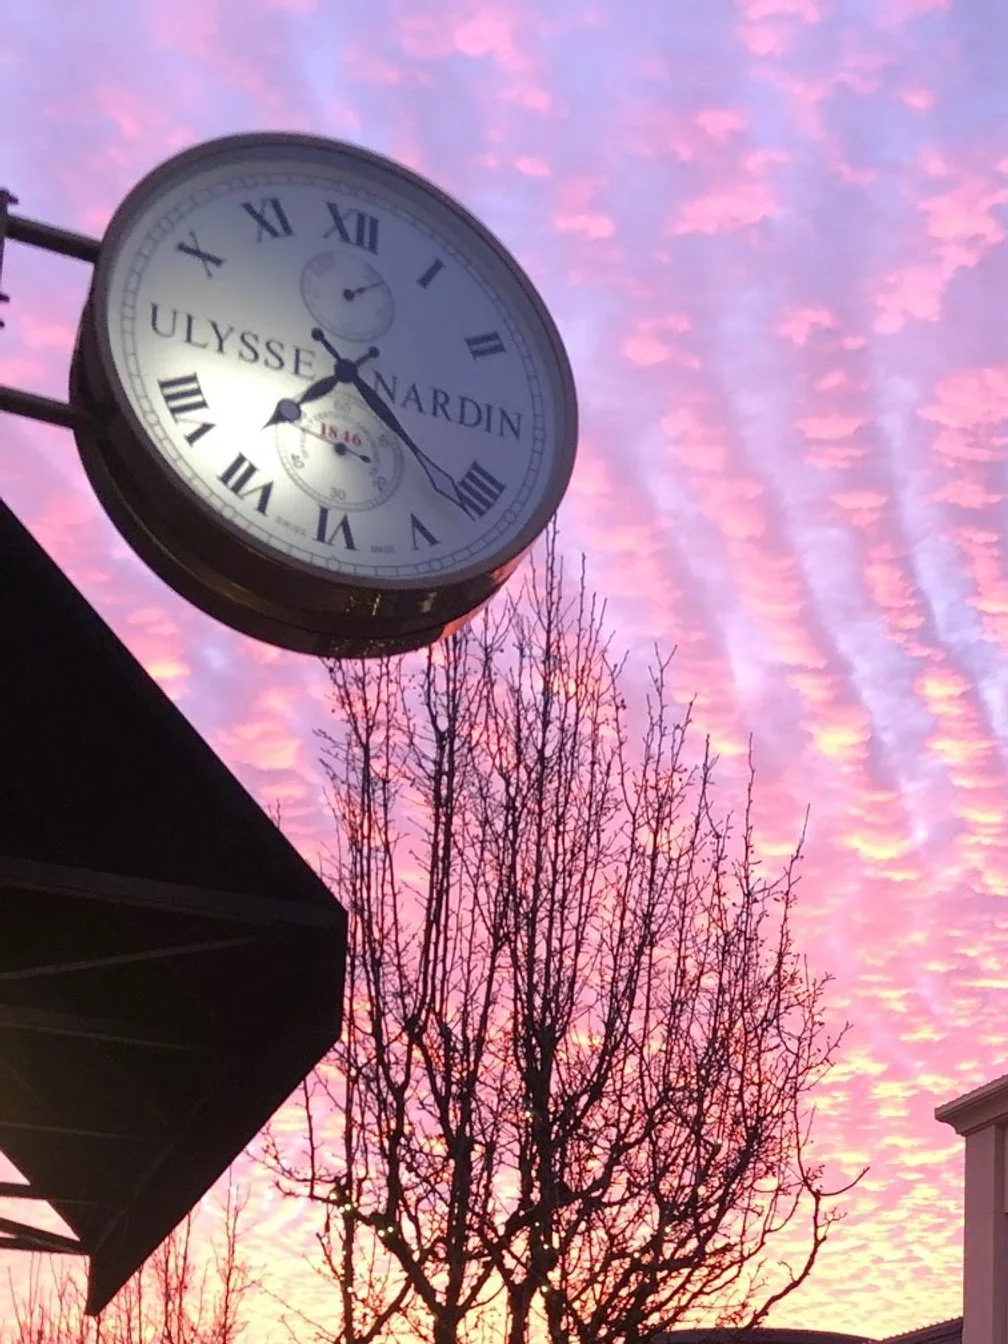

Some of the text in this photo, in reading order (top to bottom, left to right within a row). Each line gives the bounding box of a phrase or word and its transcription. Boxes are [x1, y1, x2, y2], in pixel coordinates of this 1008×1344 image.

[241, 197, 295, 243] XI
[322, 202, 380, 256] XII
[175, 229, 227, 279] X
[416, 257, 446, 290] I
[463, 329, 506, 361] II
[151, 302, 523, 441] ULYSSE NARDIN
[320, 422, 362, 447] 1846
[216, 451, 275, 517] VII
[312, 504, 361, 551] VI
[410, 512, 442, 551] V
